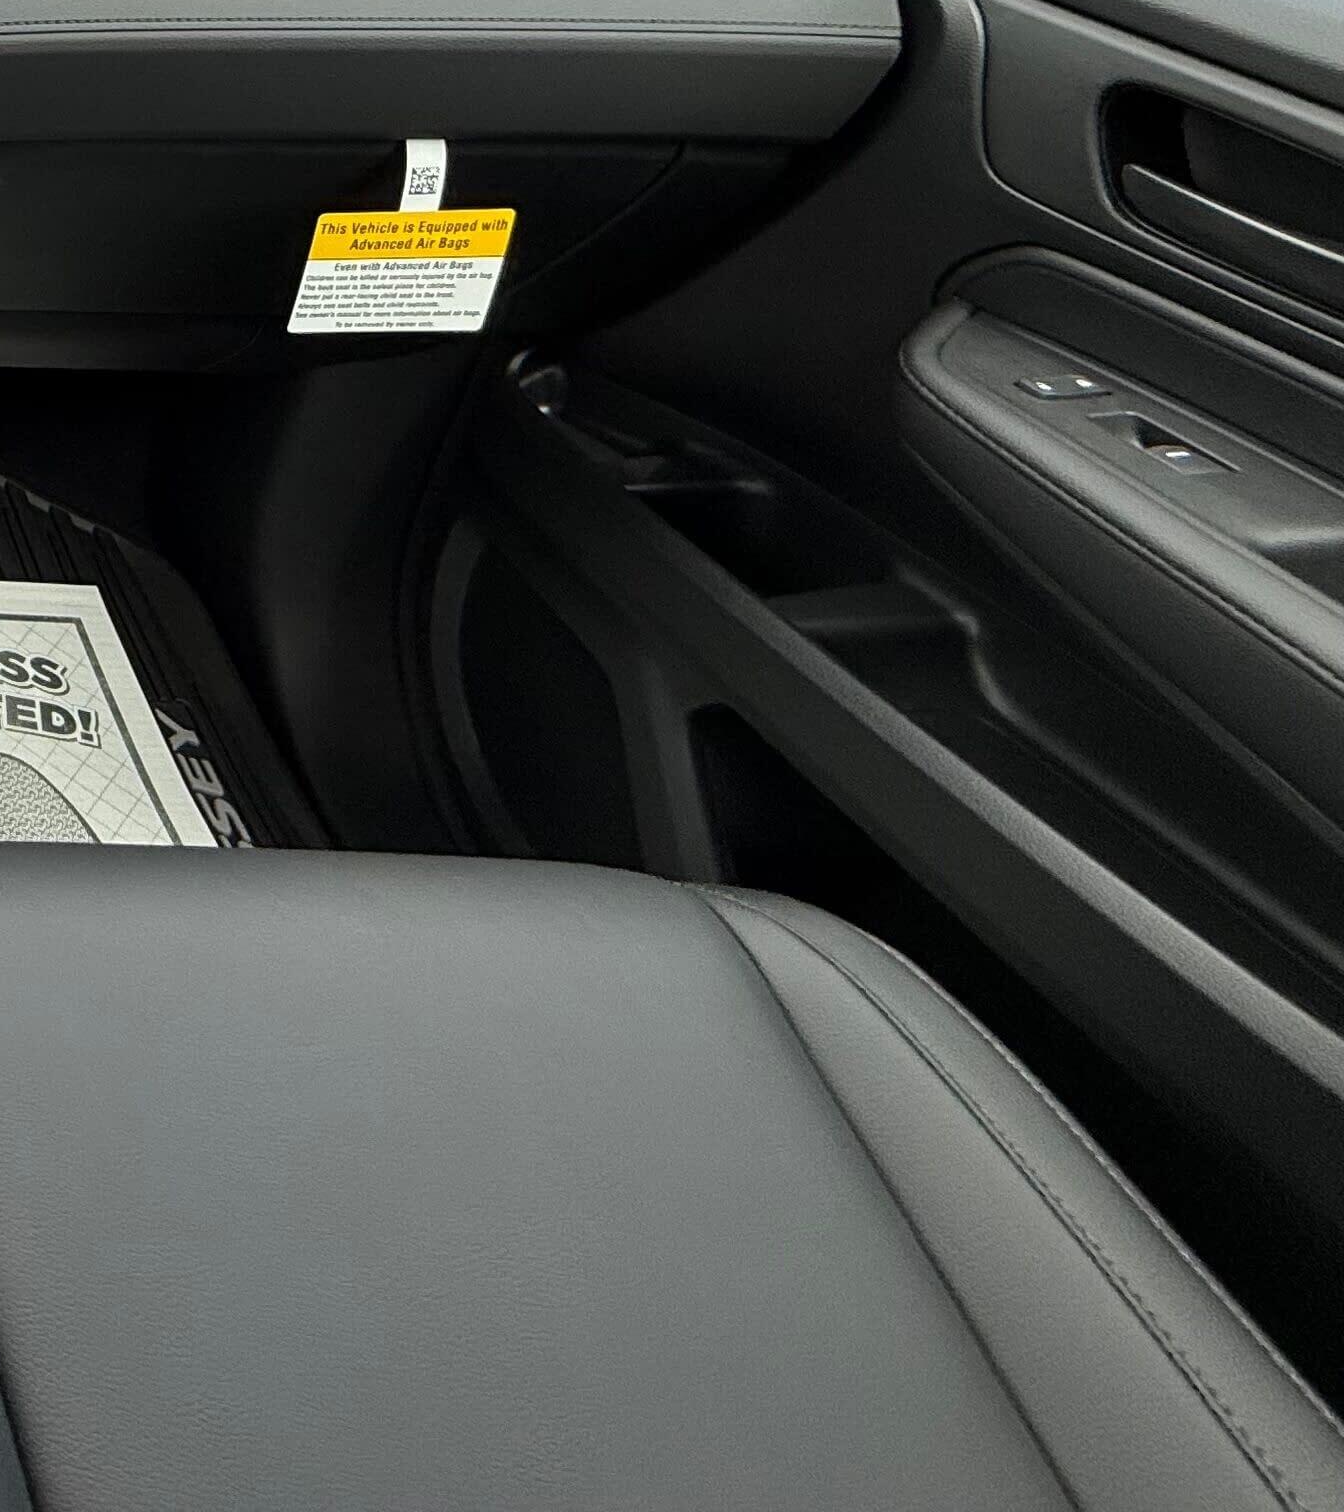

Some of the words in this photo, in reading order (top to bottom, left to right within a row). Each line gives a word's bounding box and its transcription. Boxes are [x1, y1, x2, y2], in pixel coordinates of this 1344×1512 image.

[320, 223, 347, 235] This
[352, 222, 398, 234] Vehicle
[403, 222, 414, 234] is
[418, 219, 477, 235] Equipped
[481, 219, 509, 231] with
[349, 238, 412, 251] Advanced
[417, 238, 436, 249] Air
[438, 237, 470, 251] Bags
[334, 263, 358, 271] Even
[360, 262, 381, 271] with
[383, 261, 430, 271] Advanced
[432, 261, 447, 270] Air
[449, 261, 474, 270] Bags
